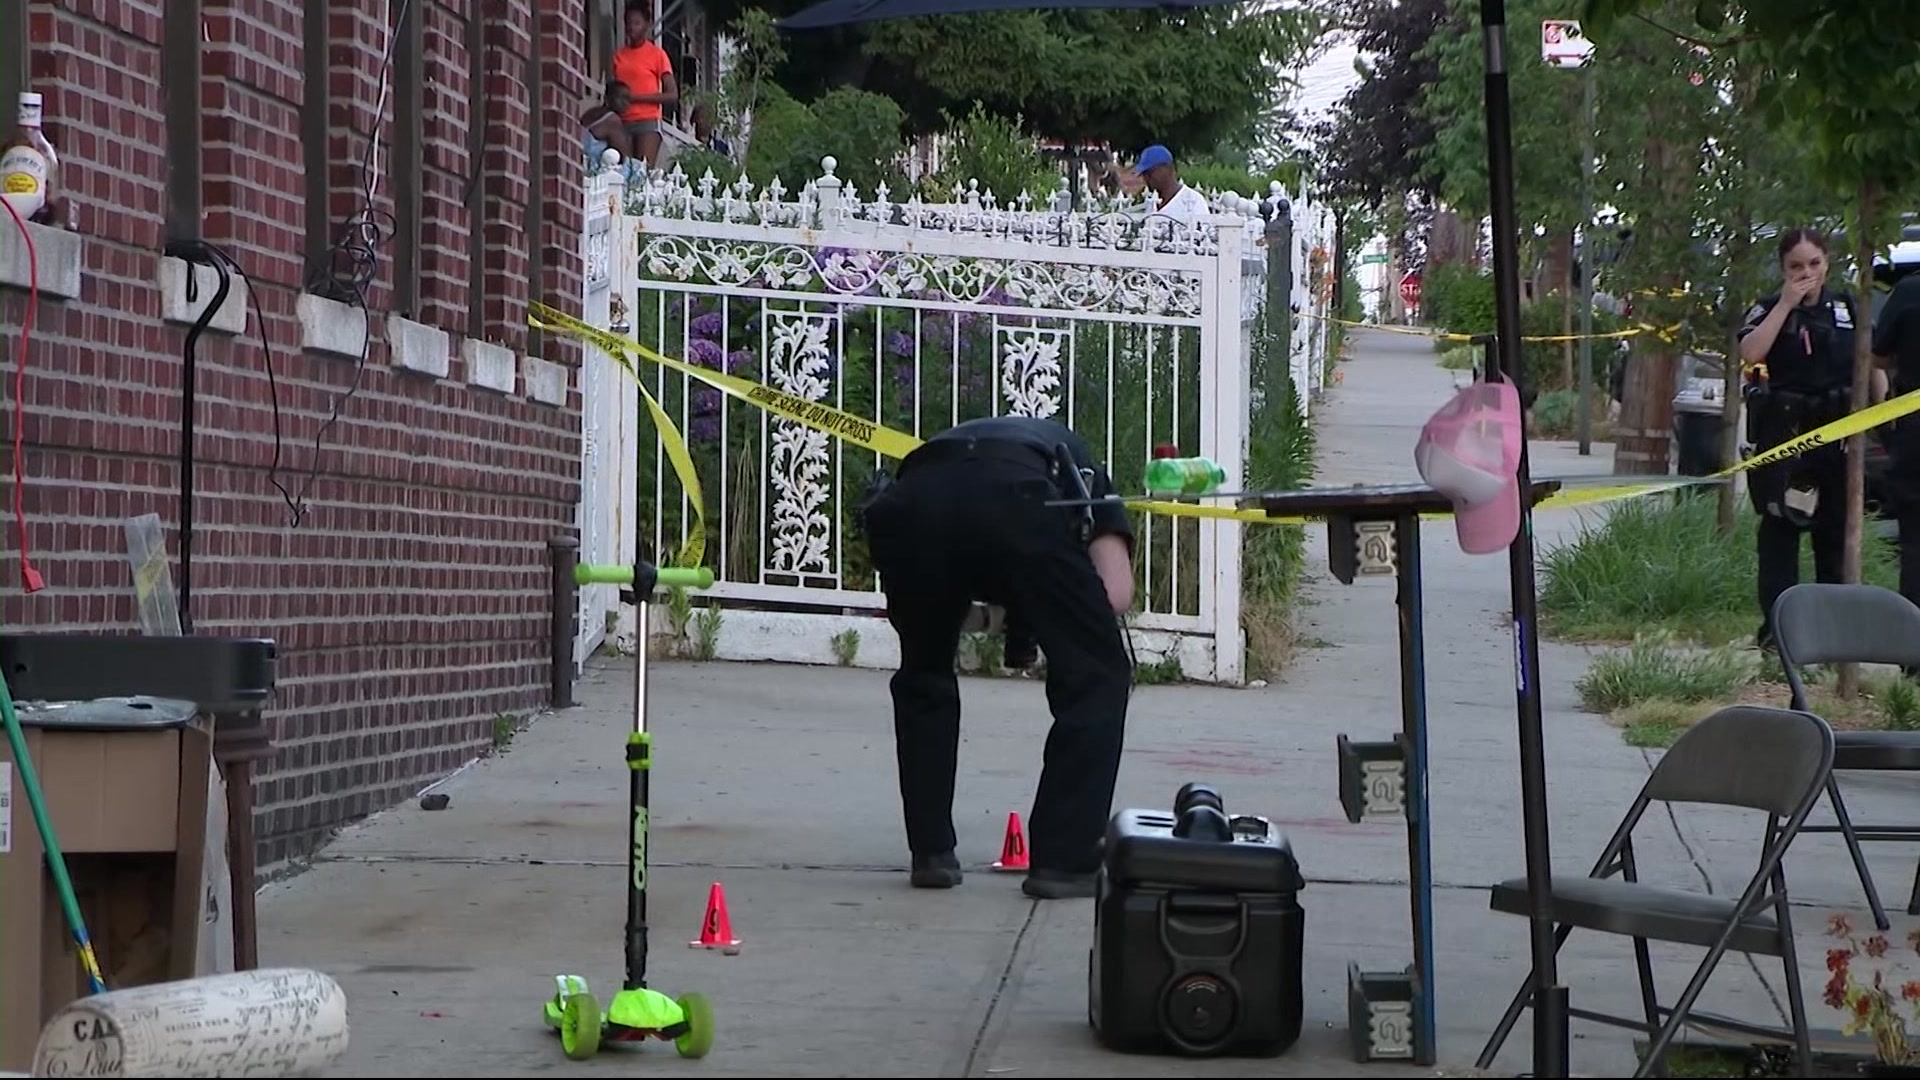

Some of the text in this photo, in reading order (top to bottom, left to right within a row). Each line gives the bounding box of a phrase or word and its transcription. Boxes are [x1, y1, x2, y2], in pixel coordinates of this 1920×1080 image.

[805, 404, 823, 422] DO
[819, 409, 842, 431] NOT
[840, 415, 877, 444] CROSS
[1008, 832, 1024, 857] 10
[708, 908, 720, 936] 9
